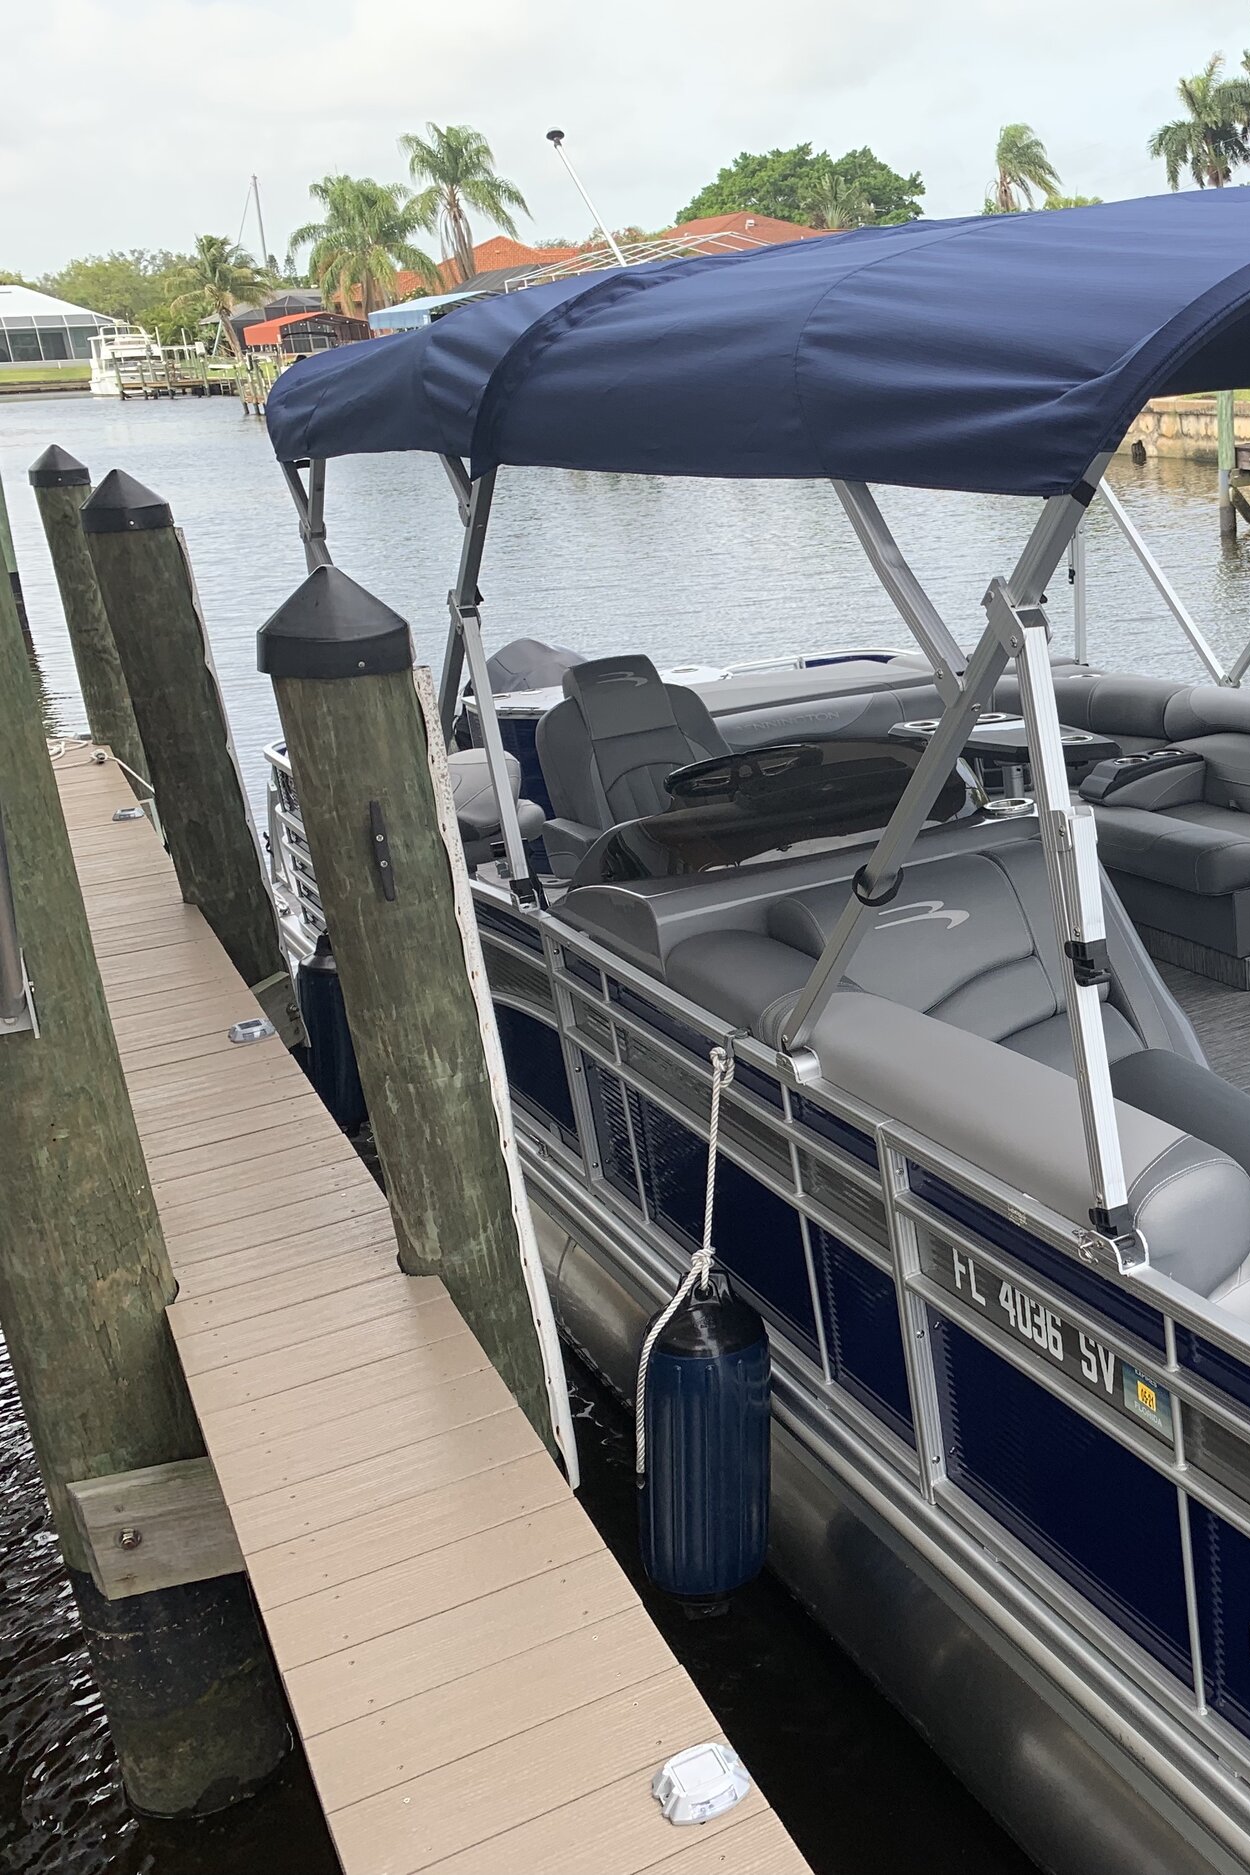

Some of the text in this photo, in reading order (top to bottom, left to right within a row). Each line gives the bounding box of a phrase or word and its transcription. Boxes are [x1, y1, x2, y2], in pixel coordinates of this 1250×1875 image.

[952, 1247, 1116, 1395] FL 4036 SV
[1134, 1400, 1163, 1428] FLORIDA
